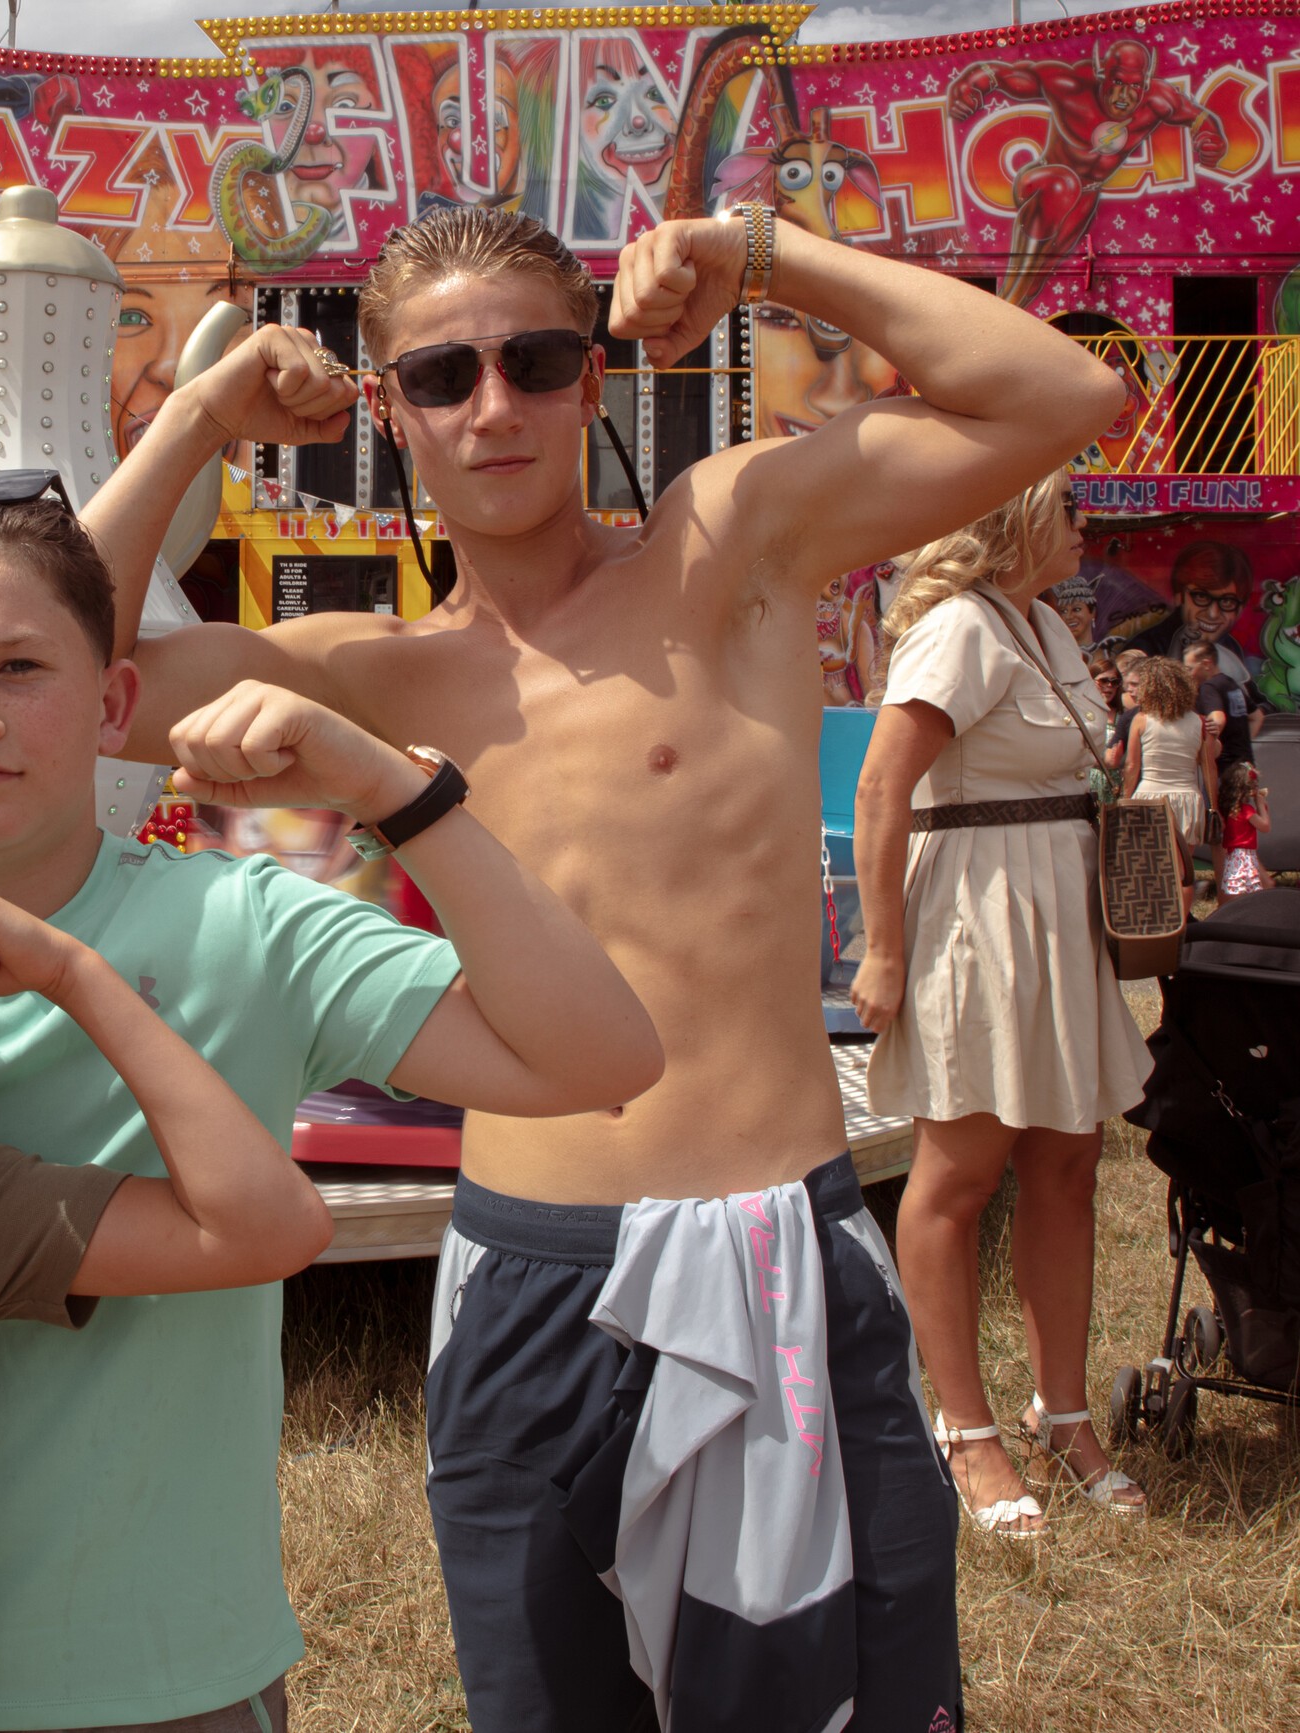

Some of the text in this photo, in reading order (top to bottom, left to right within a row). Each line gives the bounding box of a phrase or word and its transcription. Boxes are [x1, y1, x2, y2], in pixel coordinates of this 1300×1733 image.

[238, 29, 766, 252] FUN
[1071, 480, 1261, 507] FUN! FUN!
